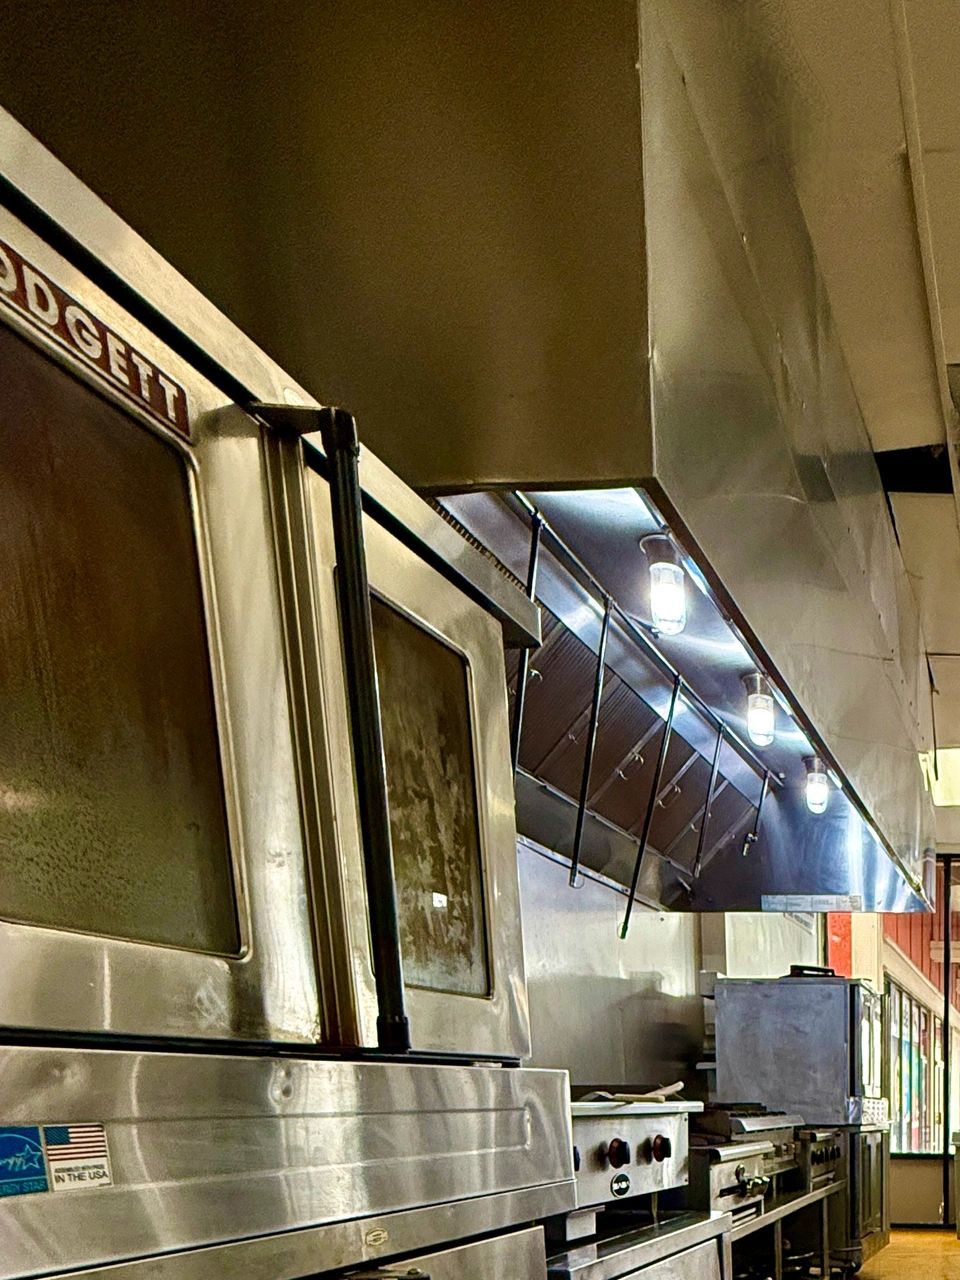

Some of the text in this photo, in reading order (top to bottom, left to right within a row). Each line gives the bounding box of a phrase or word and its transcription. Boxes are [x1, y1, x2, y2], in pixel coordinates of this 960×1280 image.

[54, 1170, 108, 1183] IN THE USA
